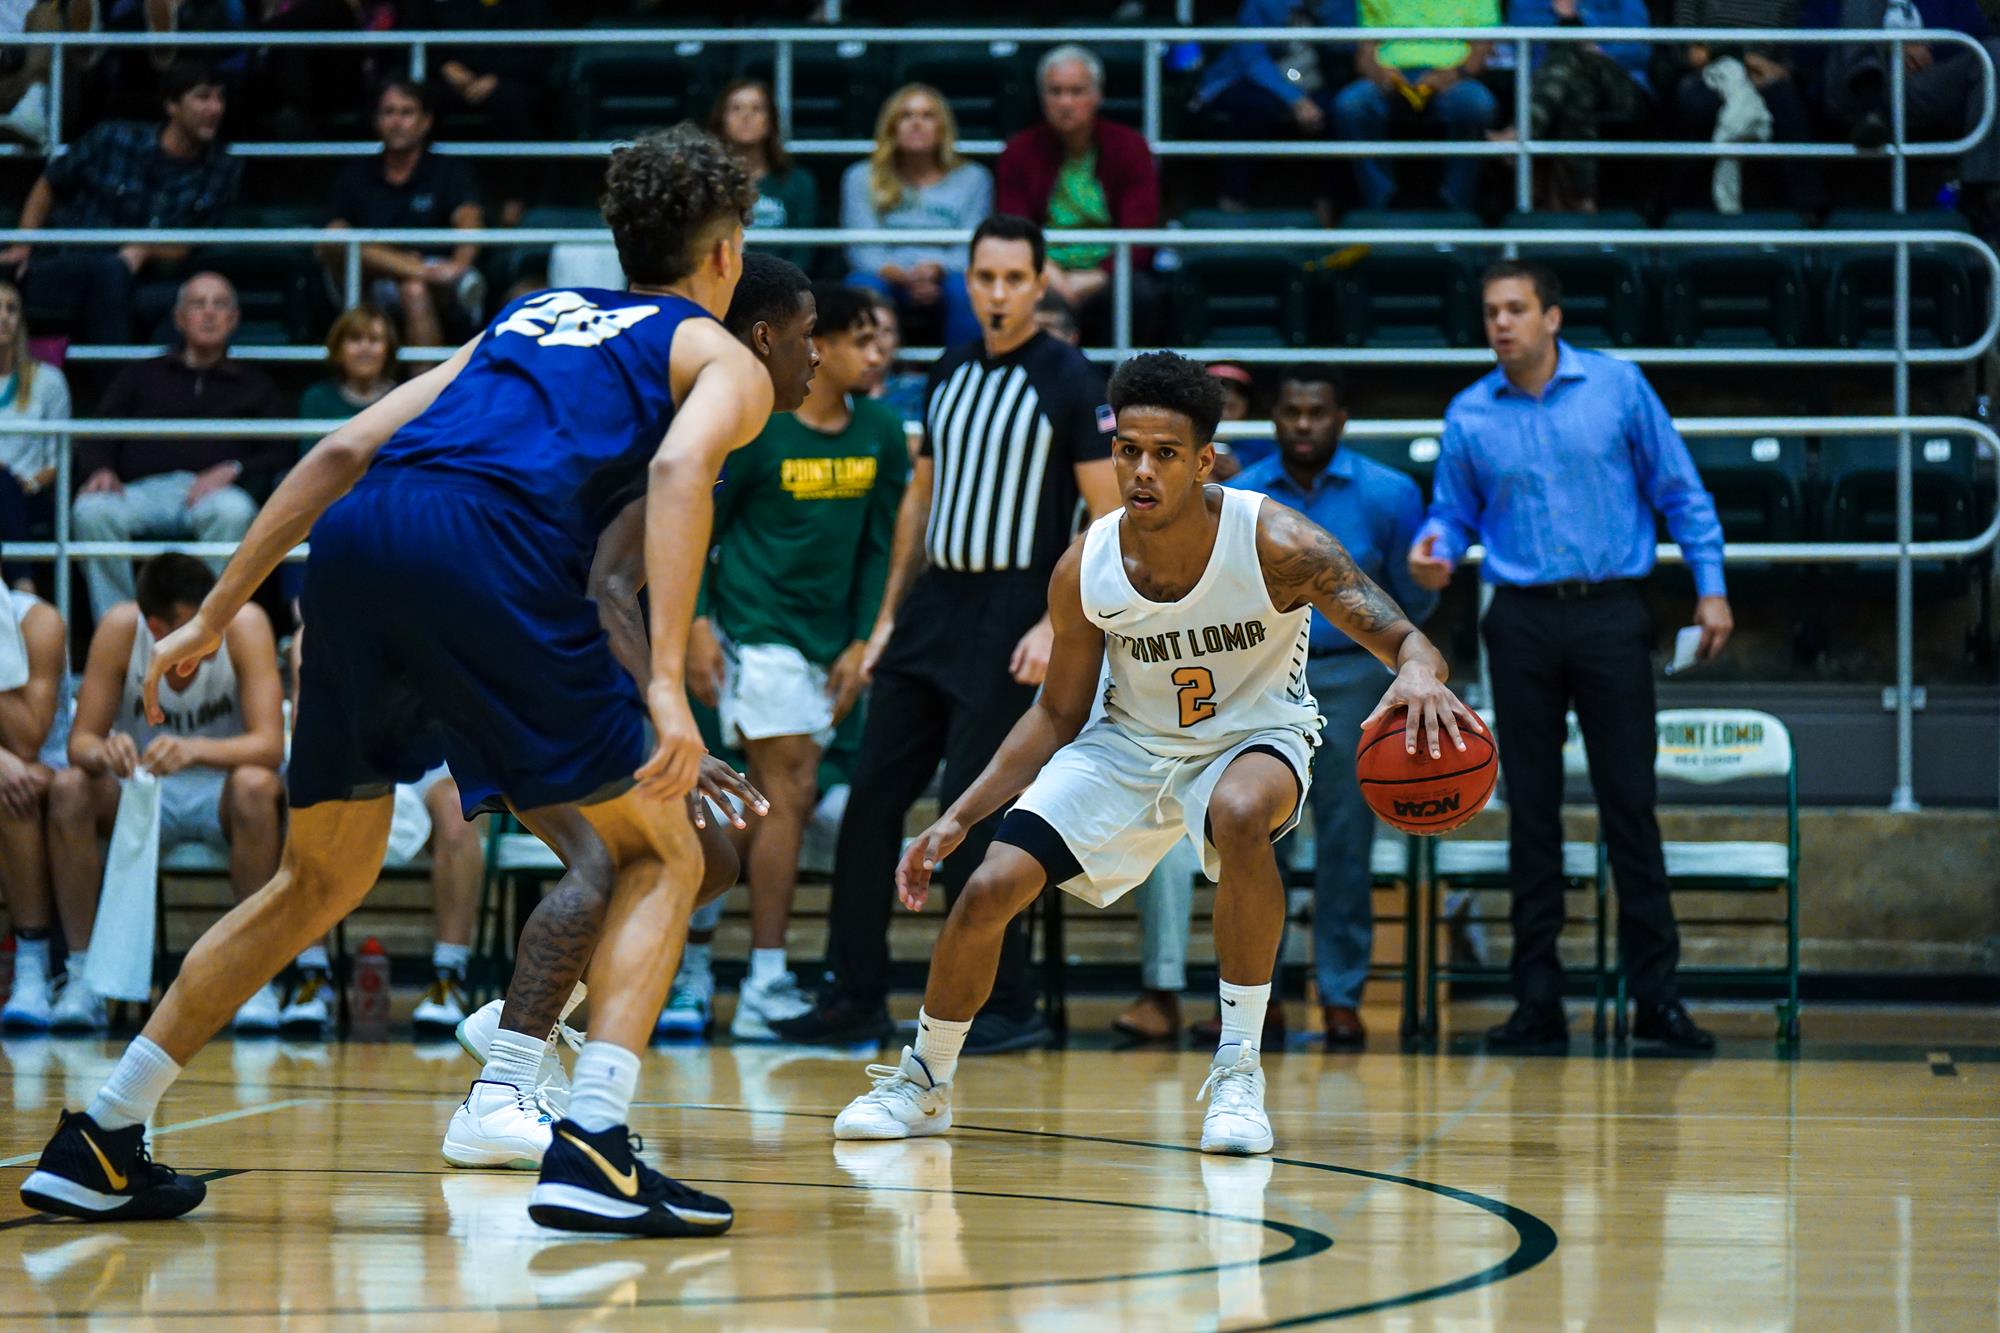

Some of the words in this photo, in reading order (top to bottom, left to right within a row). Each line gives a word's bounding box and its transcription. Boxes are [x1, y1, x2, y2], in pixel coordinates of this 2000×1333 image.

[1187, 620, 1266, 657] LOMA
[1171, 666, 1217, 728] 2
[1393, 792, 1460, 817] NCAA
